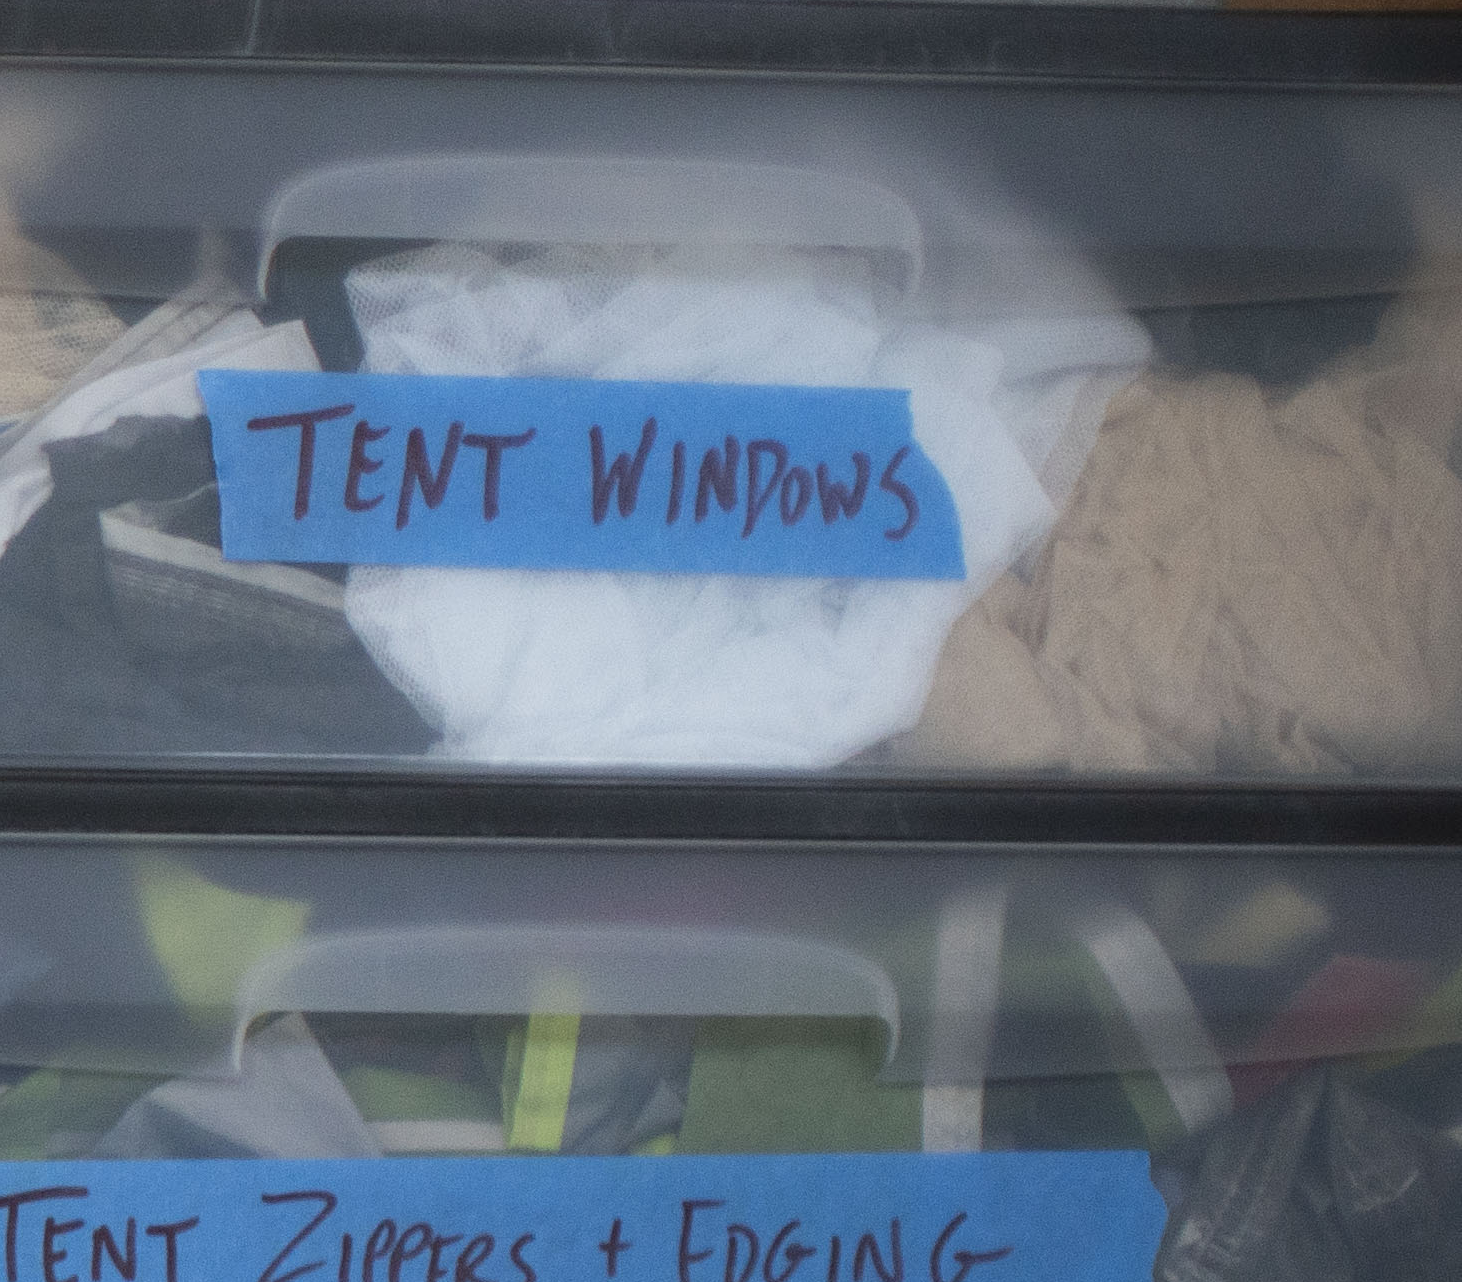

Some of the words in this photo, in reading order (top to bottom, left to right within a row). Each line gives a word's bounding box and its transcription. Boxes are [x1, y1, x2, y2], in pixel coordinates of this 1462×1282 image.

[246, 403, 538, 531] TENT
[588, 416, 921, 541] WINDOWS
[597, 1216, 634, 1279] +
